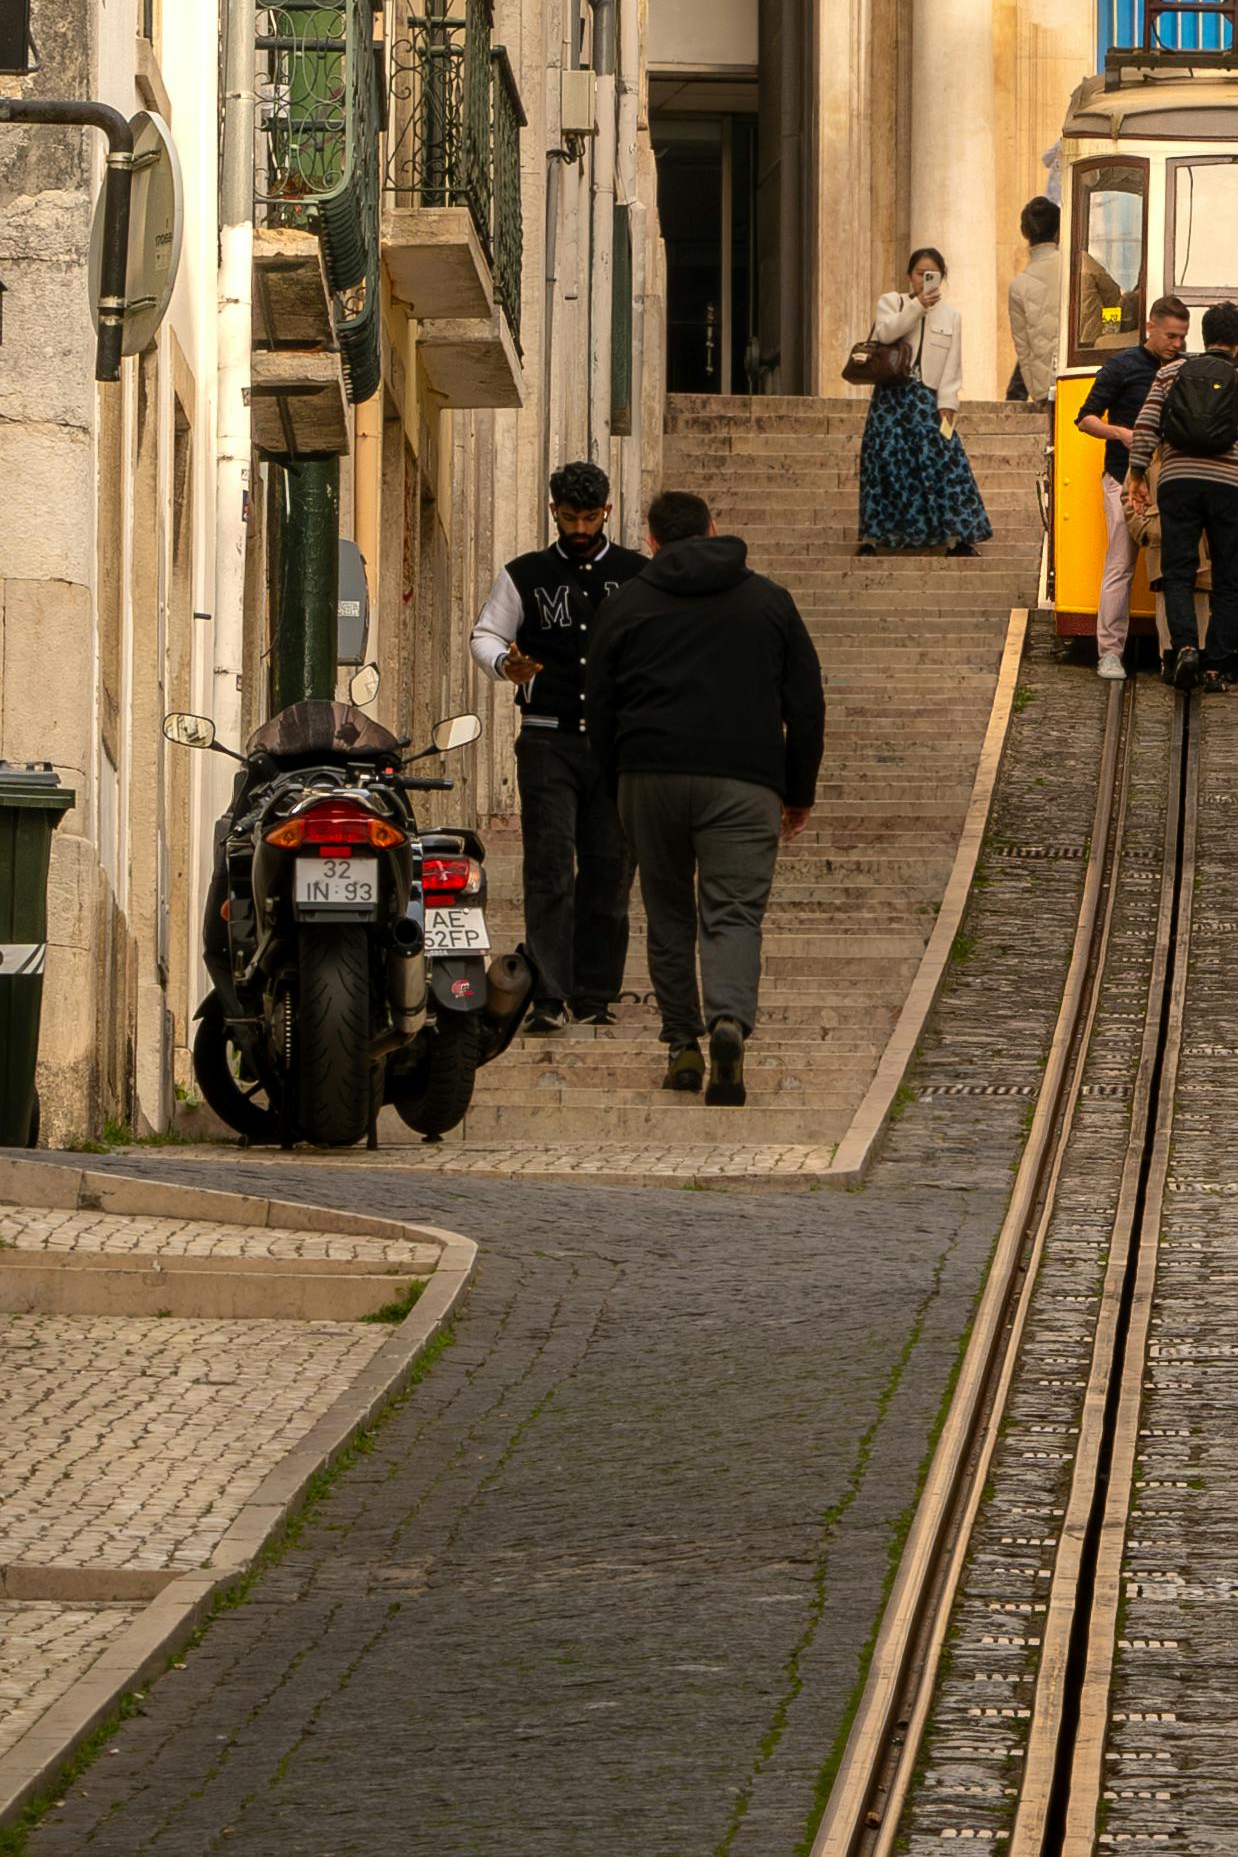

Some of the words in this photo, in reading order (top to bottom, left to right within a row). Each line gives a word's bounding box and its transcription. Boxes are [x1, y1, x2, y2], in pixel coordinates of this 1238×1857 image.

[534, 586, 572, 629] M
[324, 860, 351, 879] 32
[433, 911, 465, 928] AE
[425, 930, 479, 947] 52FP
